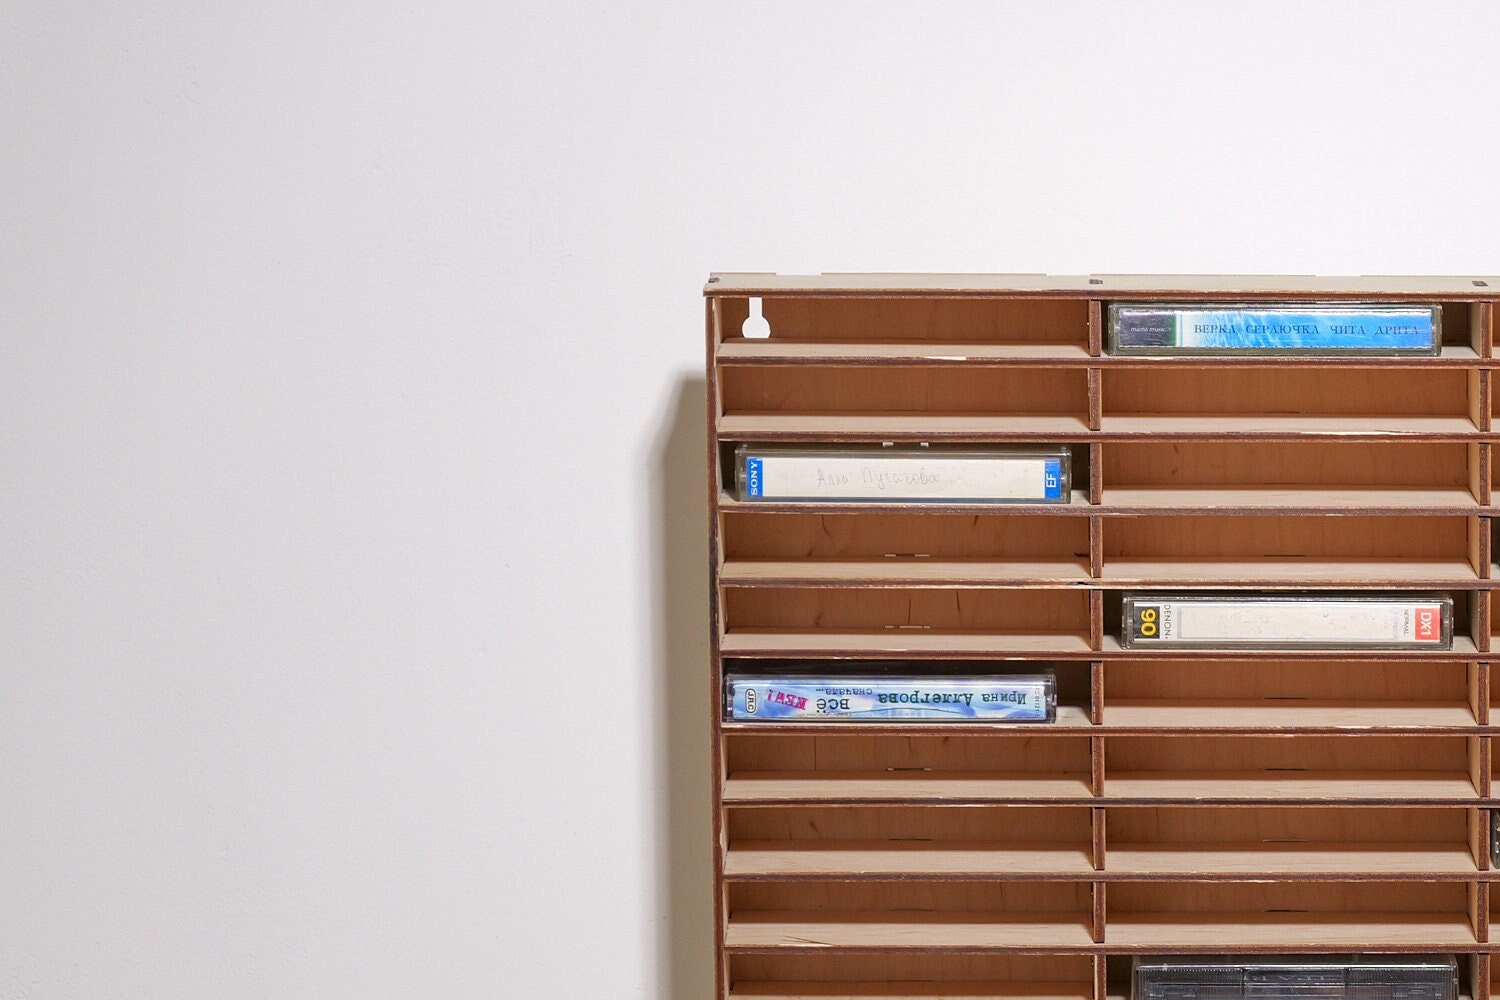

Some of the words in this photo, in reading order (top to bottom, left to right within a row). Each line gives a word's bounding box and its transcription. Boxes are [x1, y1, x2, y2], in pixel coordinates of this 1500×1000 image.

[1194, 324, 1236, 335] ВЕРКА
[1245, 324, 1320, 335] СЕРДЮЧКА
[1330, 324, 1365, 335] ЧИТА
[750, 461, 759, 496] SONY
[1046, 473, 1057, 488] EF
[1140, 608, 1156, 637] 90
[1163, 604, 1171, 637] DENON
[1420, 611, 1432, 636] DX1
[877, 692, 972, 706] Аллегрова
[981, 692, 1028, 706] Ирина
